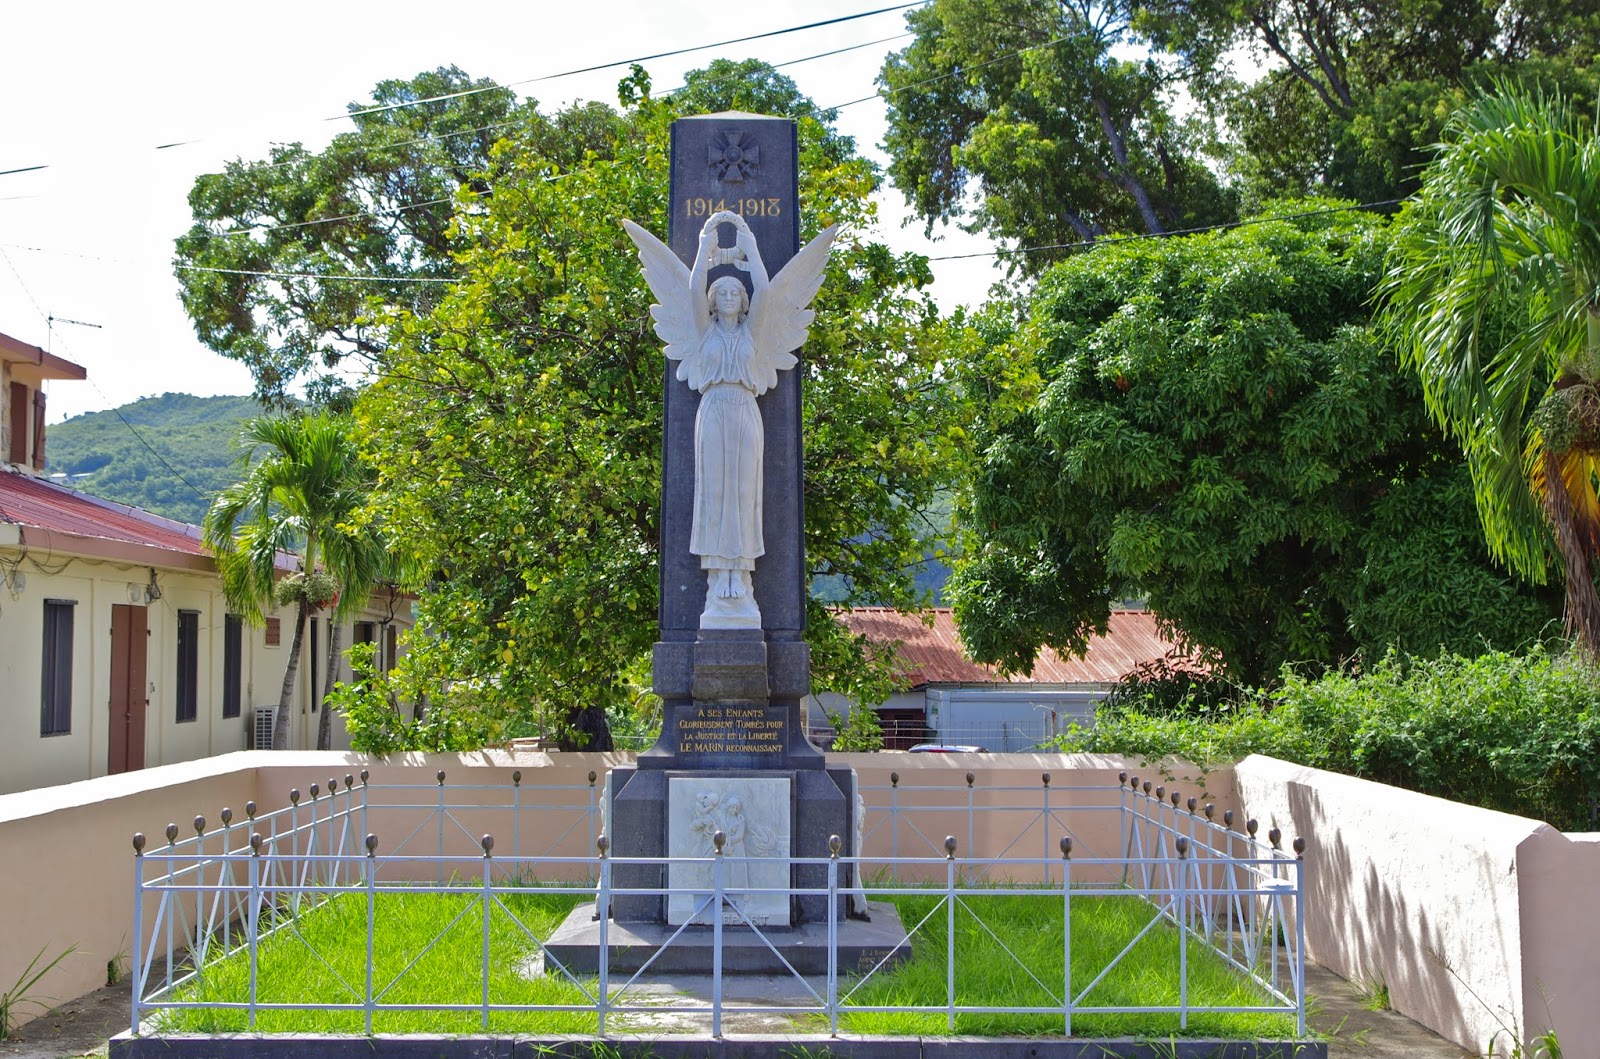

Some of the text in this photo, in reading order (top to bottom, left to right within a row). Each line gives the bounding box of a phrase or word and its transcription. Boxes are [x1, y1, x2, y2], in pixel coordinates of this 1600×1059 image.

[685, 198, 781, 217] 1914-1918
[698, 708, 764, 718] A SES ENFANTS
[766, 720, 784, 729] POUR
[684, 732, 693, 740] LA
[695, 731, 725, 740] JUSTICE
[727, 732, 737, 740] ET
[738, 732, 748, 740] LA
[680, 742, 783, 753] LE MARIN RECONNAISSANT
